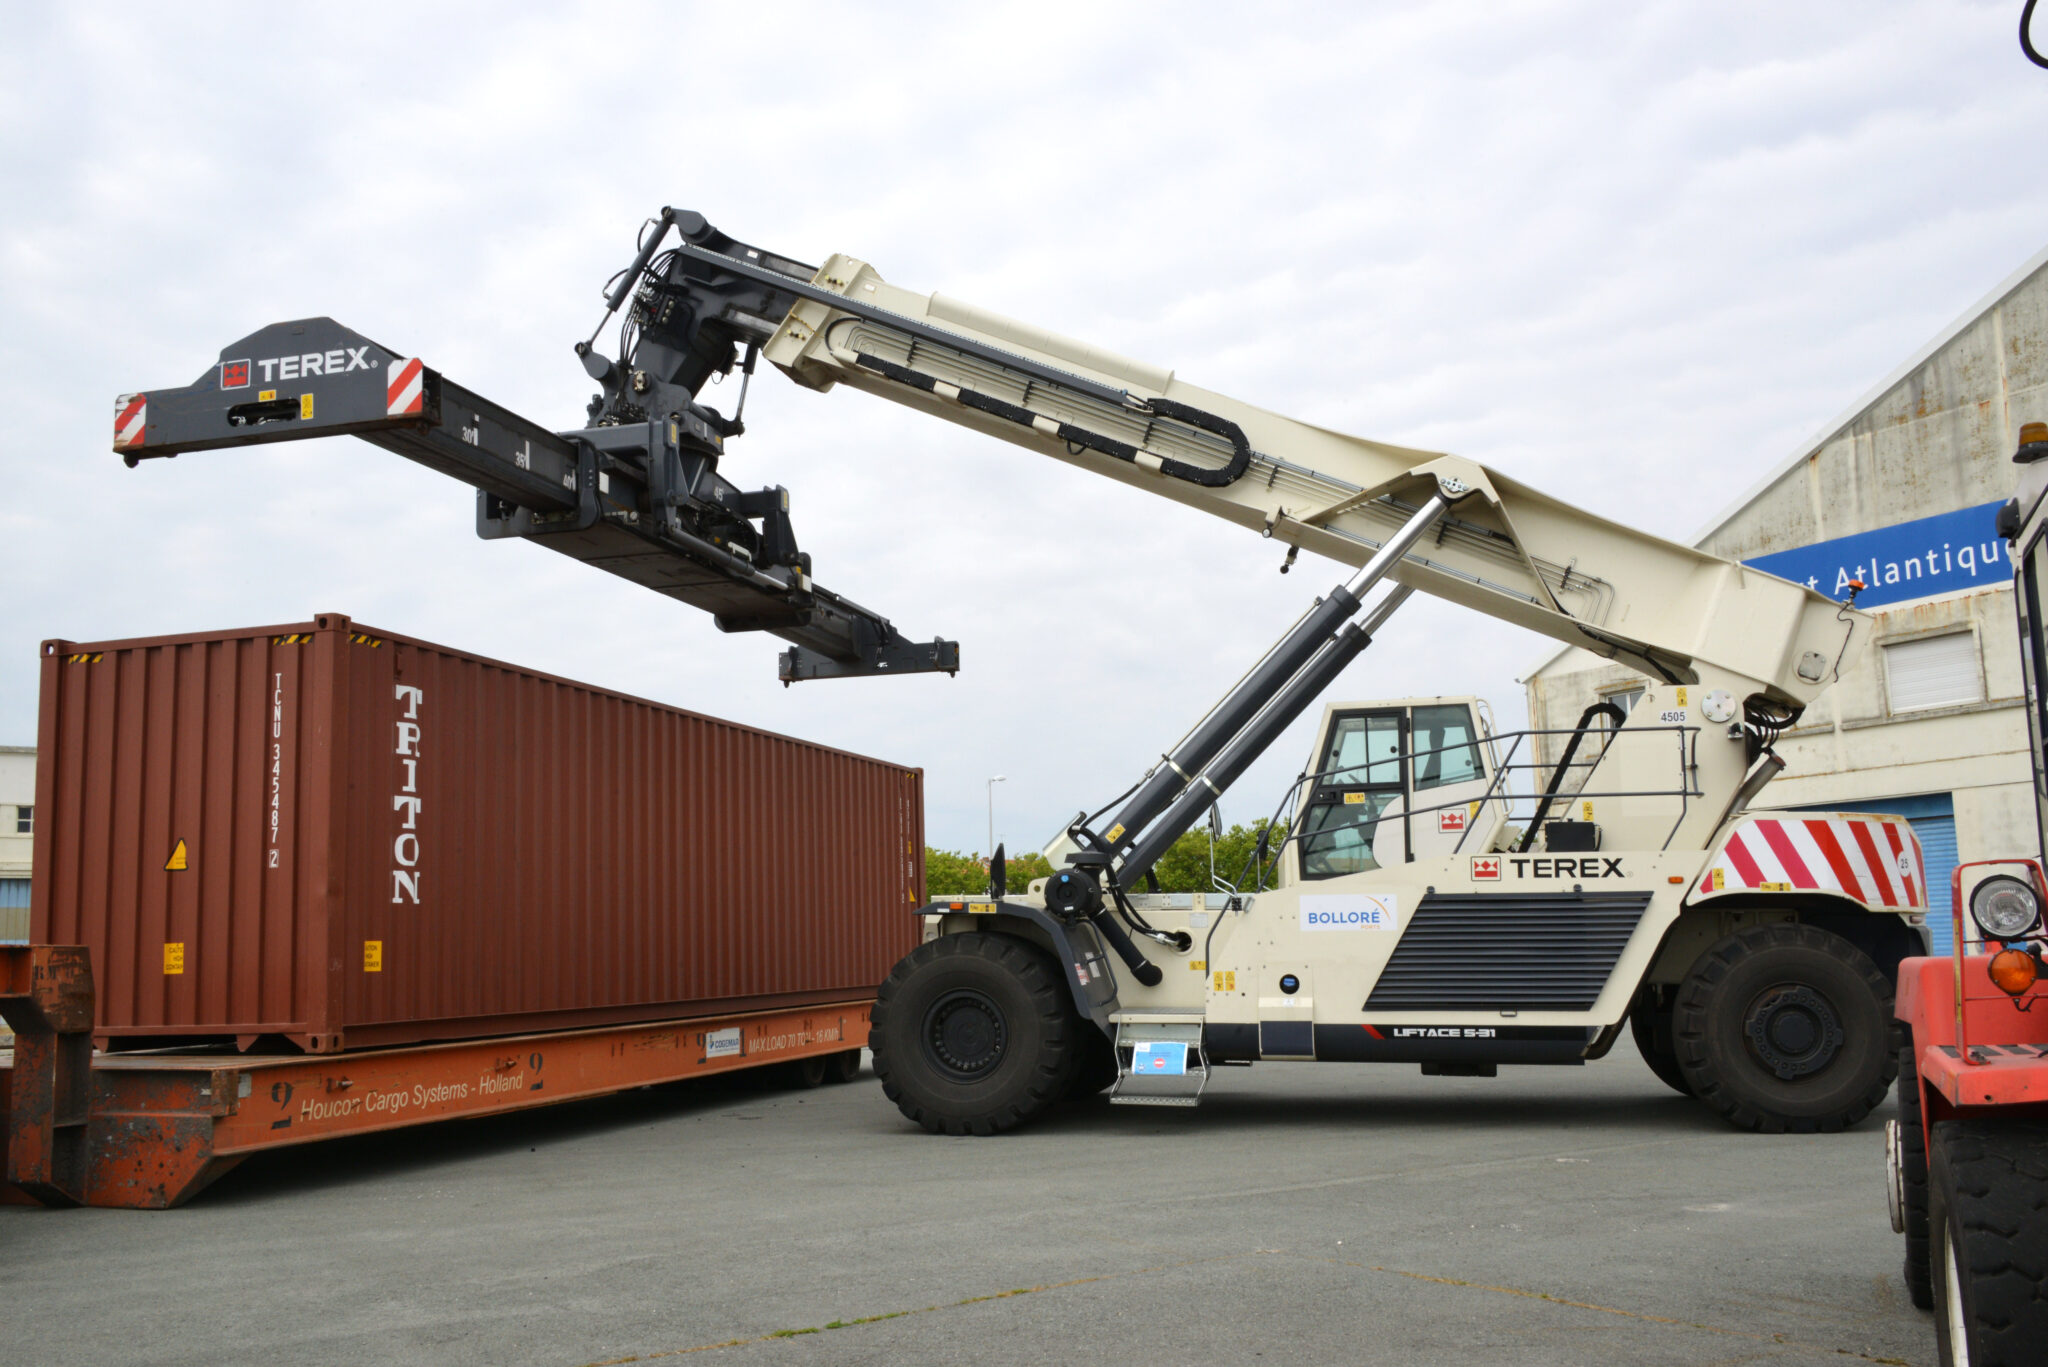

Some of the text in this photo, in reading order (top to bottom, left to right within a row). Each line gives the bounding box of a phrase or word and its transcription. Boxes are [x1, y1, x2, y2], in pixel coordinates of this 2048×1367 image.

[257, 346, 370, 383] TEREX
[1661, 711, 1686, 723] 4505
[269, 673, 282, 868] TCNU 345487 2
[391, 684, 424, 905] TRITON
[1509, 857, 1626, 878] TEREX
[1308, 907, 1381, 924] BOLLORÉ
[1393, 1028, 1461, 1038] LIFTACE
[300, 1098, 362, 1122] Houcon
[365, 1091, 409, 1114] Cargo
[412, 1081, 468, 1109] Systems
[479, 1070, 524, 1095] Holland
